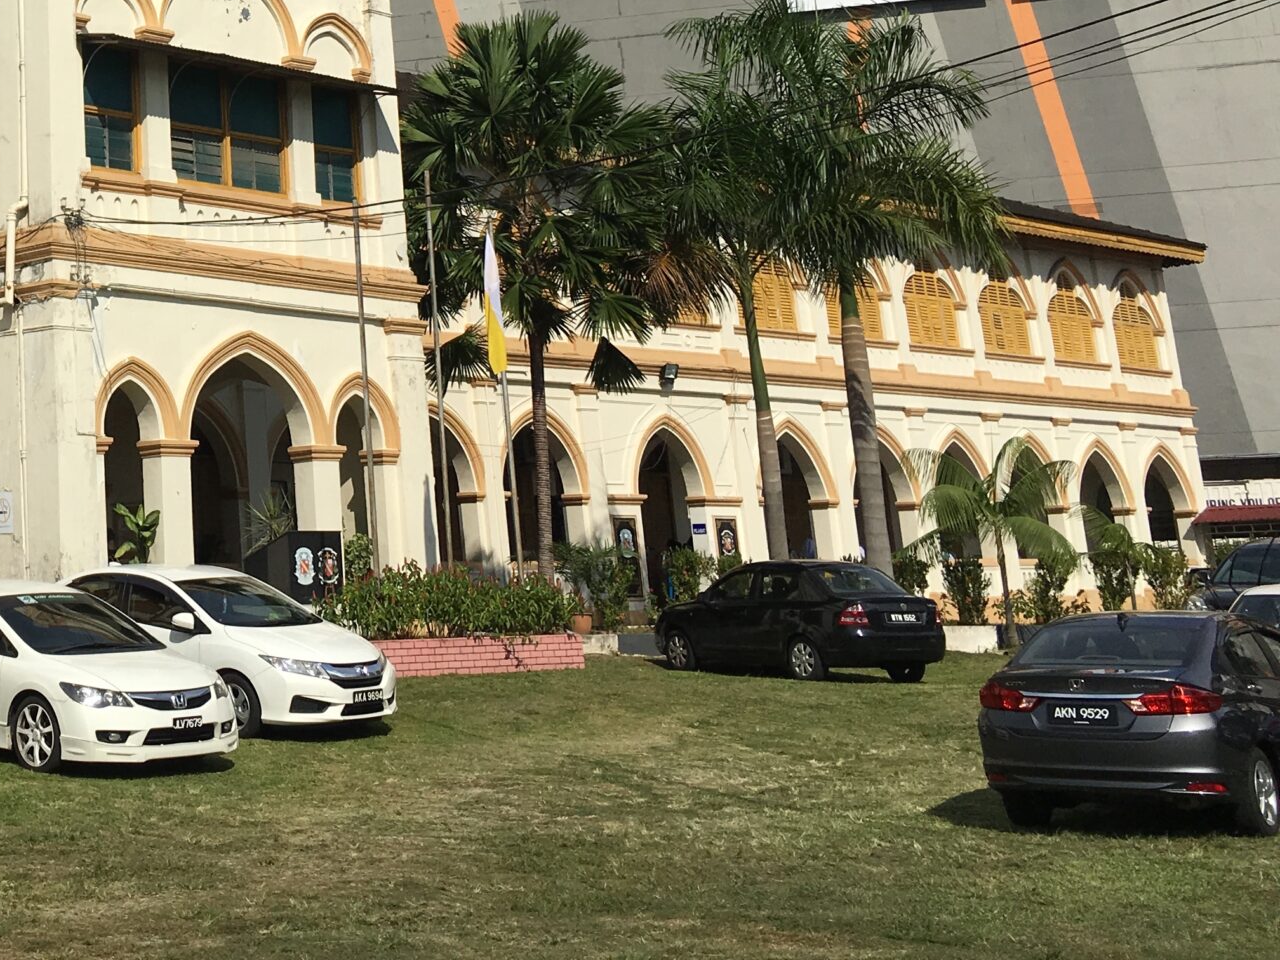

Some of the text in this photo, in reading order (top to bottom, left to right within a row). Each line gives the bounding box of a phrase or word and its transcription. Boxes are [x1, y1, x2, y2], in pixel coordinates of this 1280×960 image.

[355, 691, 367, 703] AKA
[1054, 707, 1110, 720] AKN 9529
